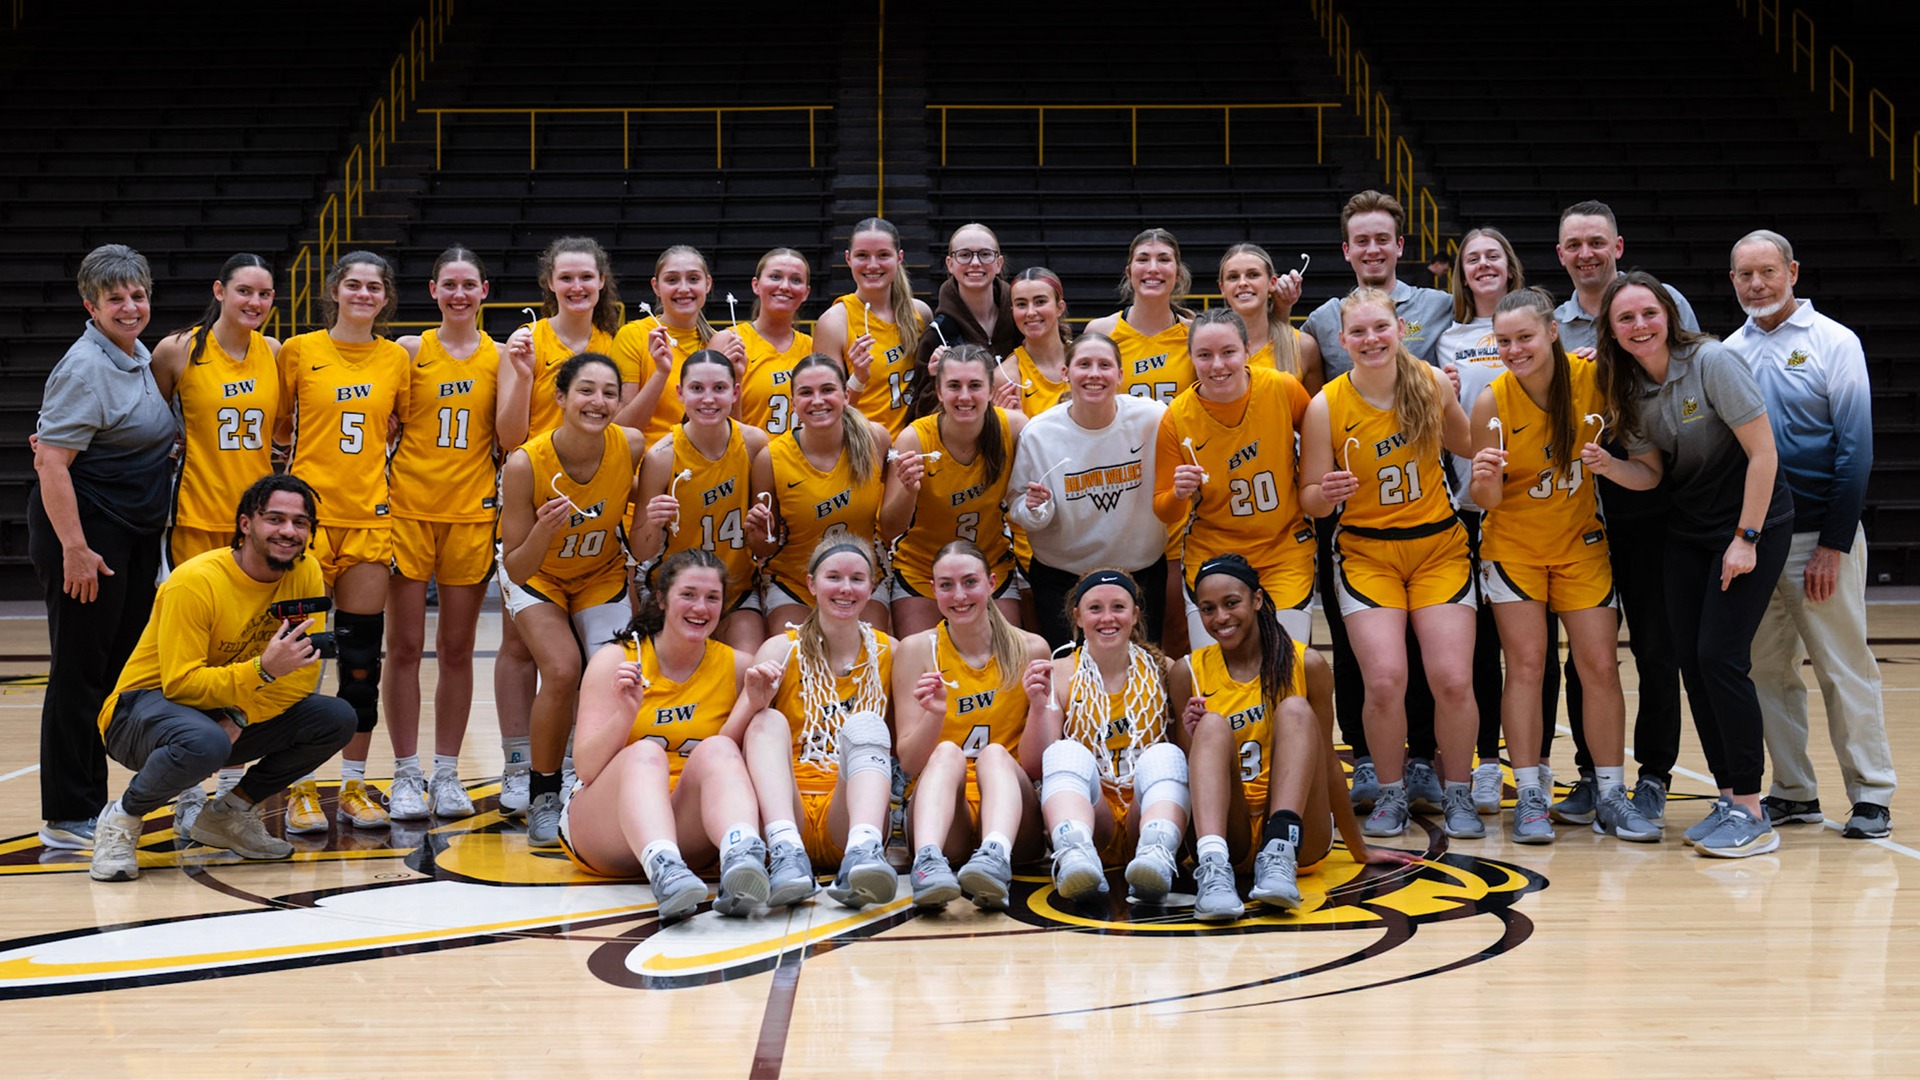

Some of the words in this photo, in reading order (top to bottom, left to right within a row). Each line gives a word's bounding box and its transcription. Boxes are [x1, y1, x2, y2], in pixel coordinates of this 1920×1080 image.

[884, 345, 905, 366] B
[1132, 352, 1170, 377] BW
[1479, 346, 1499, 356] WALLAC
[221, 378, 257, 399] BW
[334, 383, 373, 403] BW
[437, 379, 476, 399] BW
[771, 370, 793, 387] B
[217, 407, 265, 450] 23
[339, 411, 366, 455] 5
[436, 407, 470, 449] 11
[1226, 440, 1261, 473] BW
[1372, 431, 1408, 460] BW
[701, 477, 736, 508] BW
[1064, 470, 1103, 493] BALDWIN
[1377, 460, 1423, 506] 21
[1527, 458, 1584, 499] 34
[813, 487, 852, 520] BW
[949, 483, 985, 508] BW
[1229, 470, 1280, 517] 20
[568, 499, 606, 529] BW
[956, 511, 980, 543] 2
[700, 507, 745, 551] 14
[558, 530, 607, 559] 10
[652, 702, 699, 726] BW
[955, 689, 999, 716] BW
[1226, 704, 1267, 731] BW
[962, 724, 991, 763] 4
[1239, 740, 1263, 782] 3
